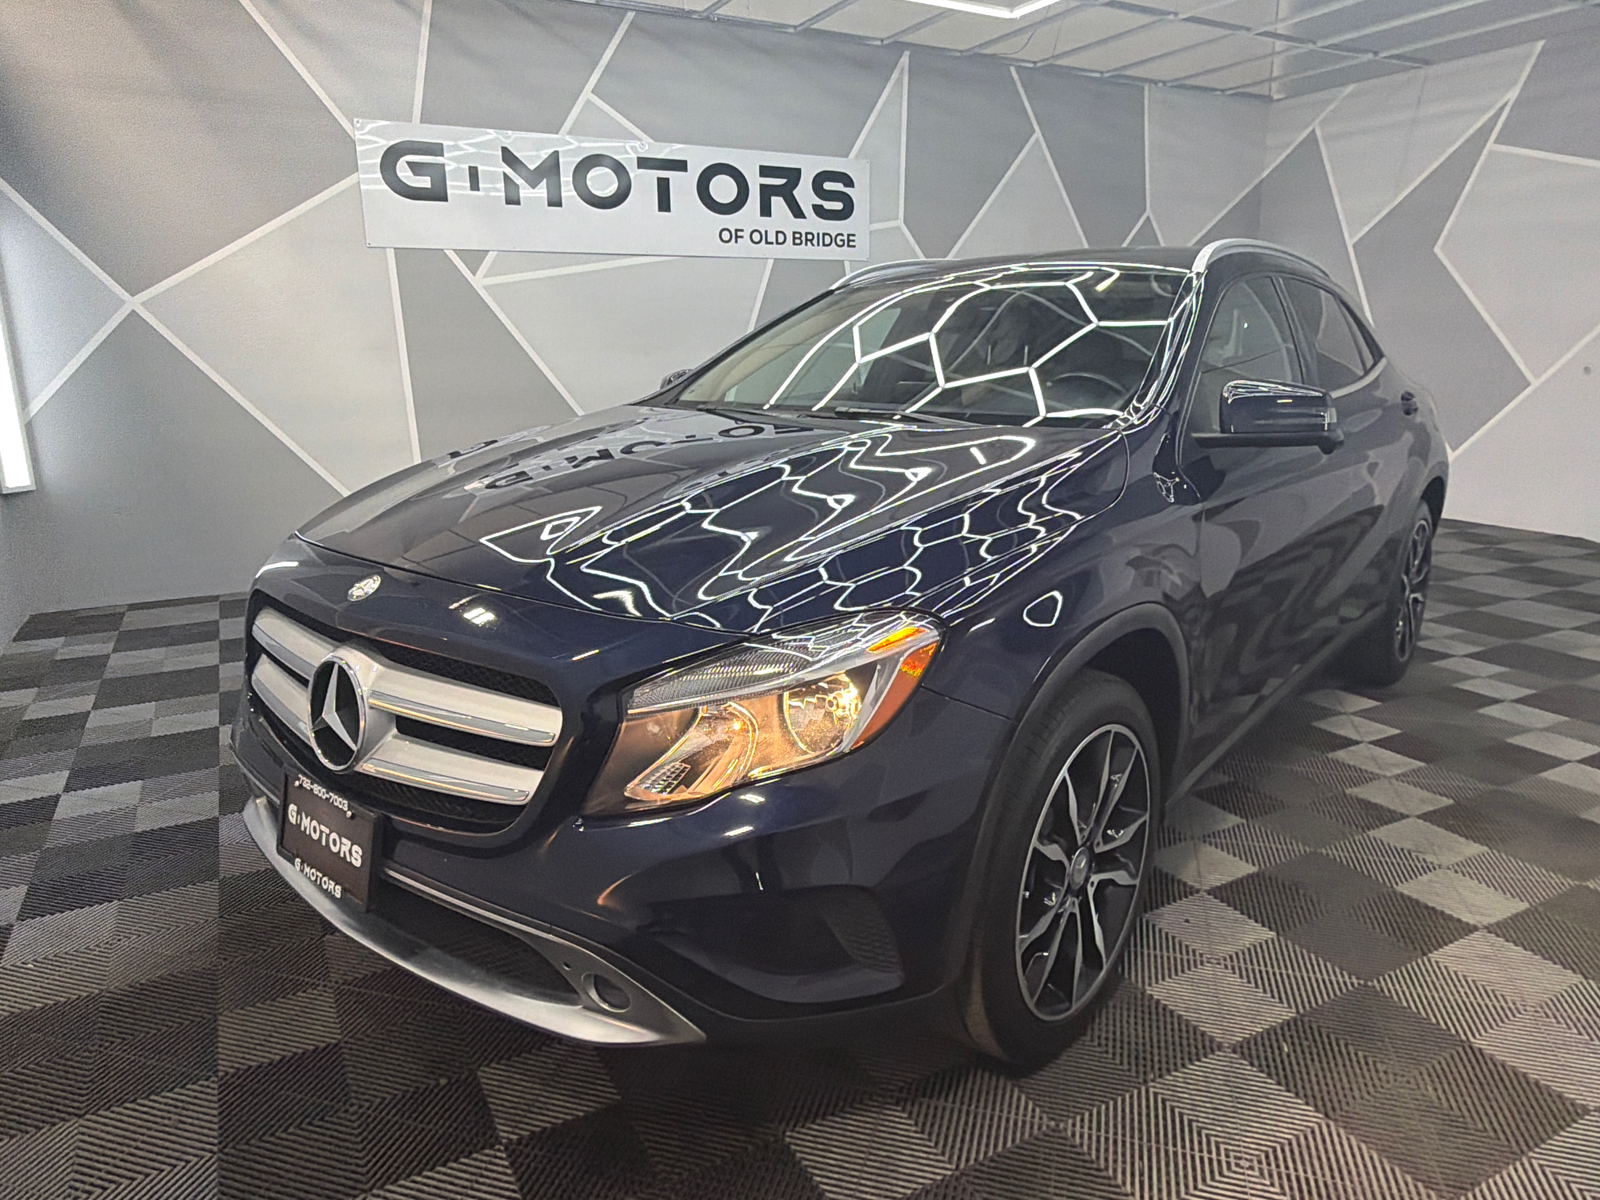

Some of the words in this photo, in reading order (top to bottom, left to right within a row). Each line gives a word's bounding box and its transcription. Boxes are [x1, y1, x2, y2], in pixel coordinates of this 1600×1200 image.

[719, 228, 745, 244] OF
[750, 230, 787, 246] OLD
[793, 231, 857, 248] BRIDGE
